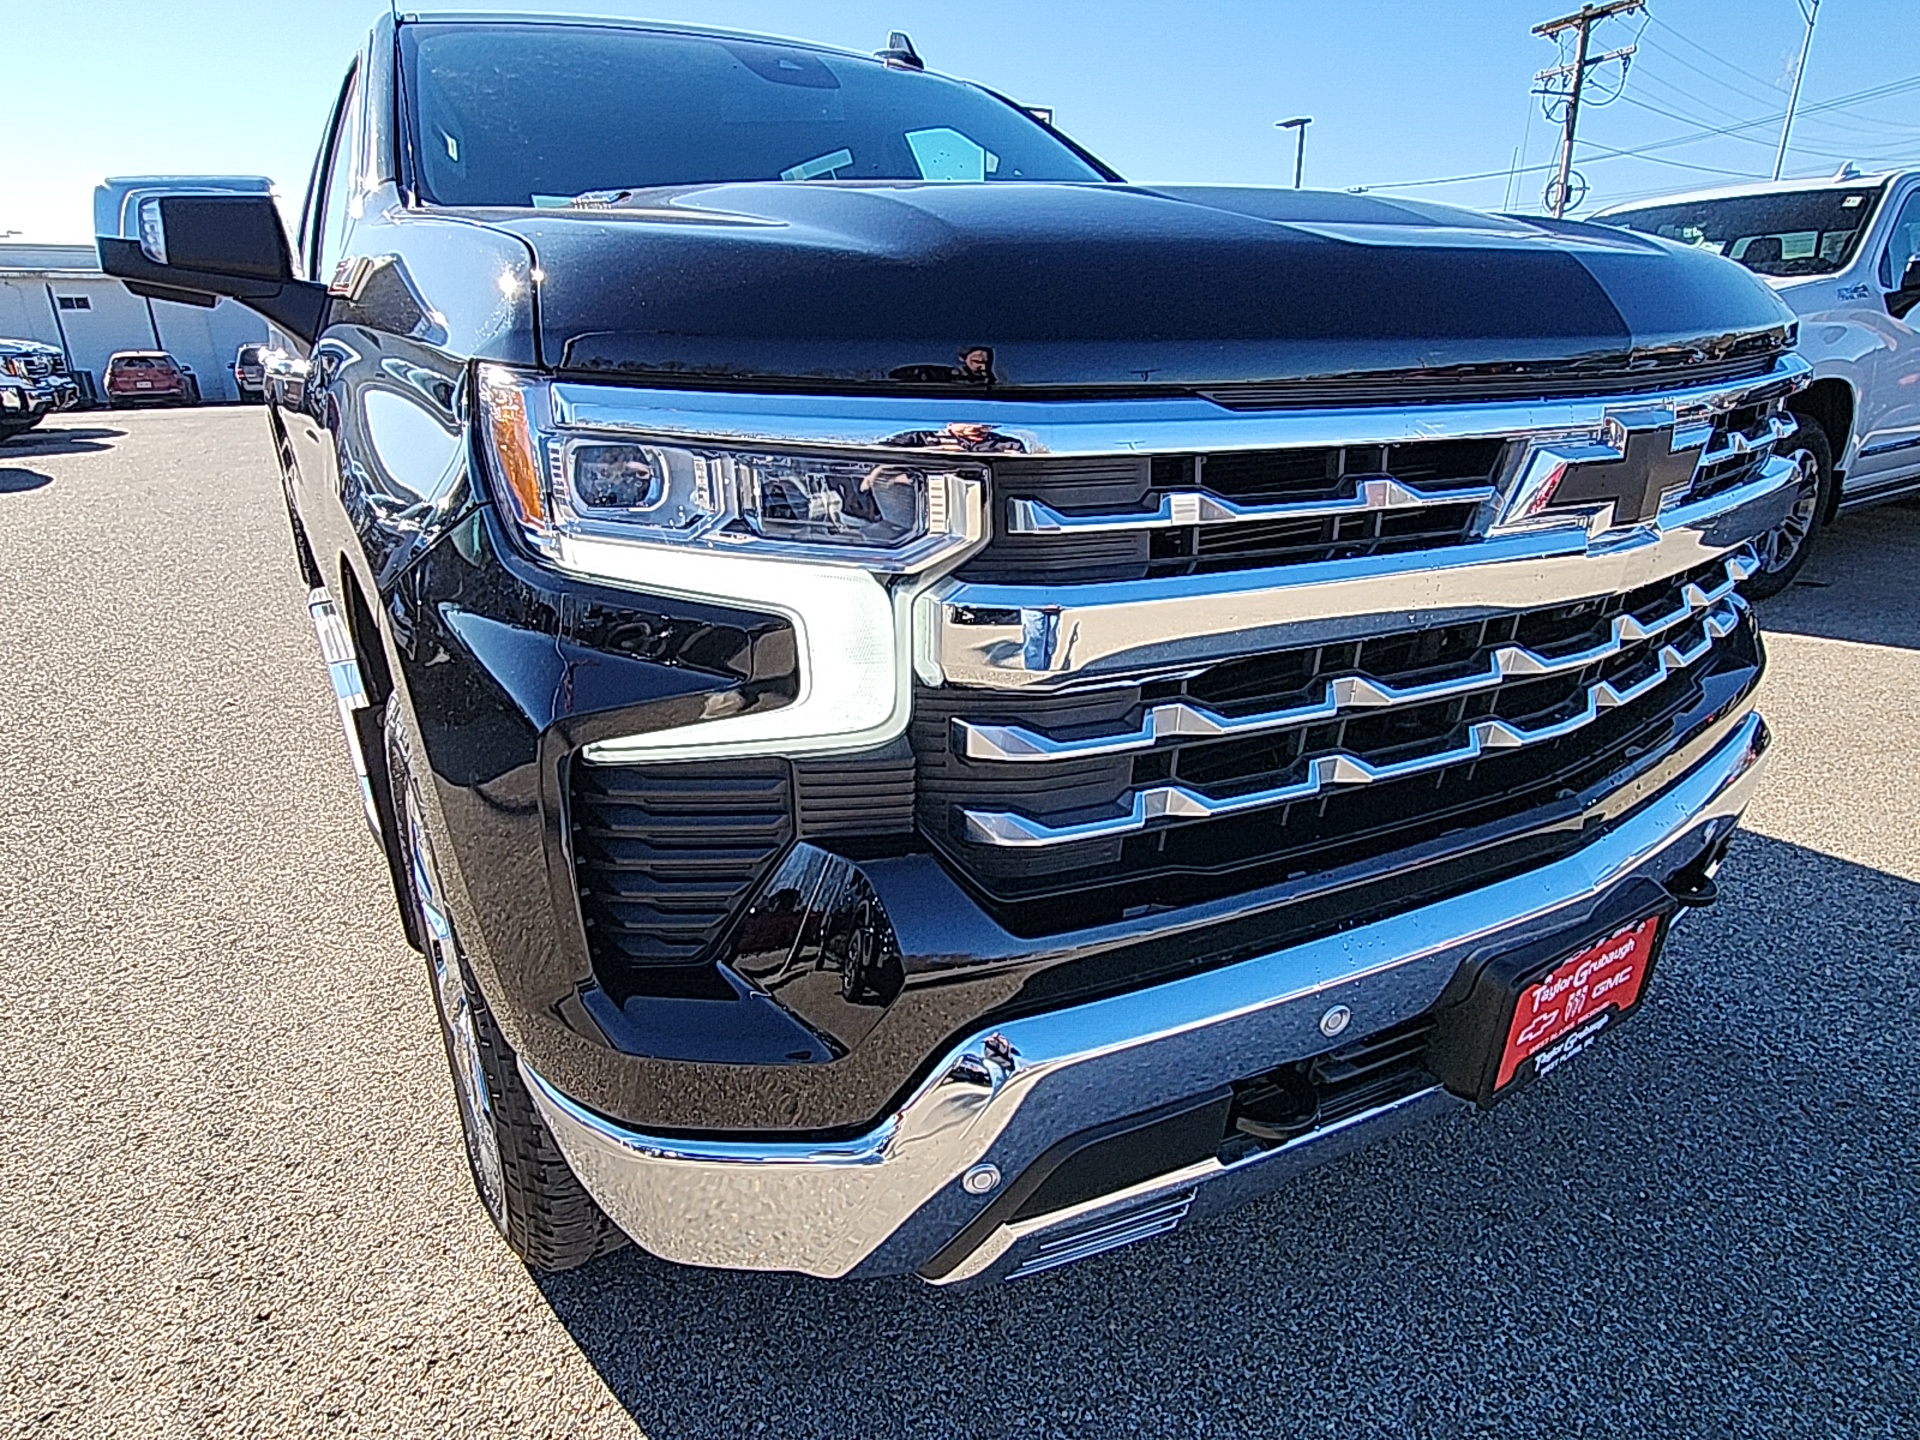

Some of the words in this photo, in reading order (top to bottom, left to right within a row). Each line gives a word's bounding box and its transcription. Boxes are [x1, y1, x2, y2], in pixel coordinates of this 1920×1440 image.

[1532, 974, 1574, 1013] Taylor
[1573, 938, 1635, 988] Grubaugh
[1591, 965, 1633, 999] GMC
